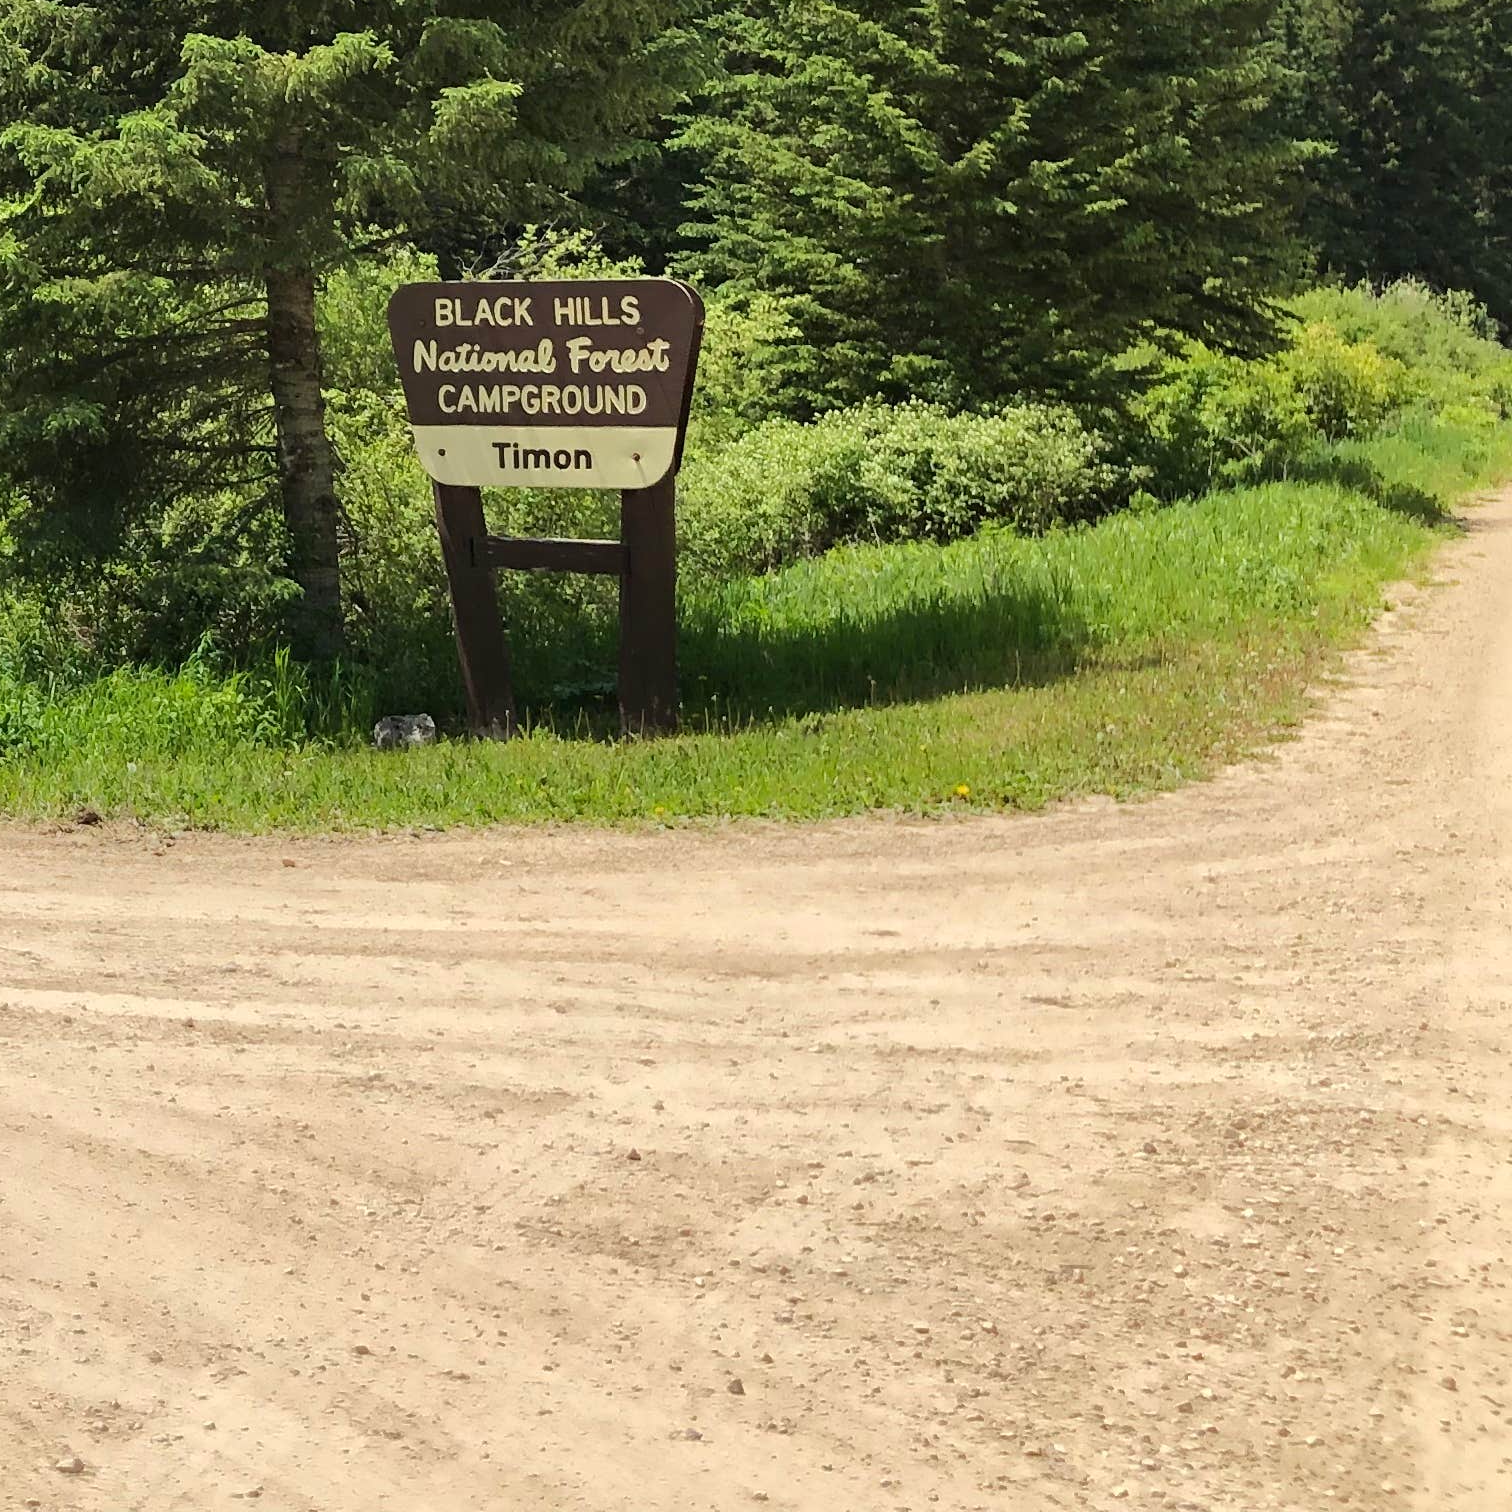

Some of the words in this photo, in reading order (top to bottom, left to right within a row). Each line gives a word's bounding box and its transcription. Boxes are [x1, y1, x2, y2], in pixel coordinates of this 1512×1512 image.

[435, 296, 533, 327] BLACK
[554, 295, 641, 326] HILLS
[413, 337, 557, 374] National
[566, 336, 670, 374] Forest
[438, 384, 647, 415] CAMPGROUND
[492, 442, 593, 470] Timon
